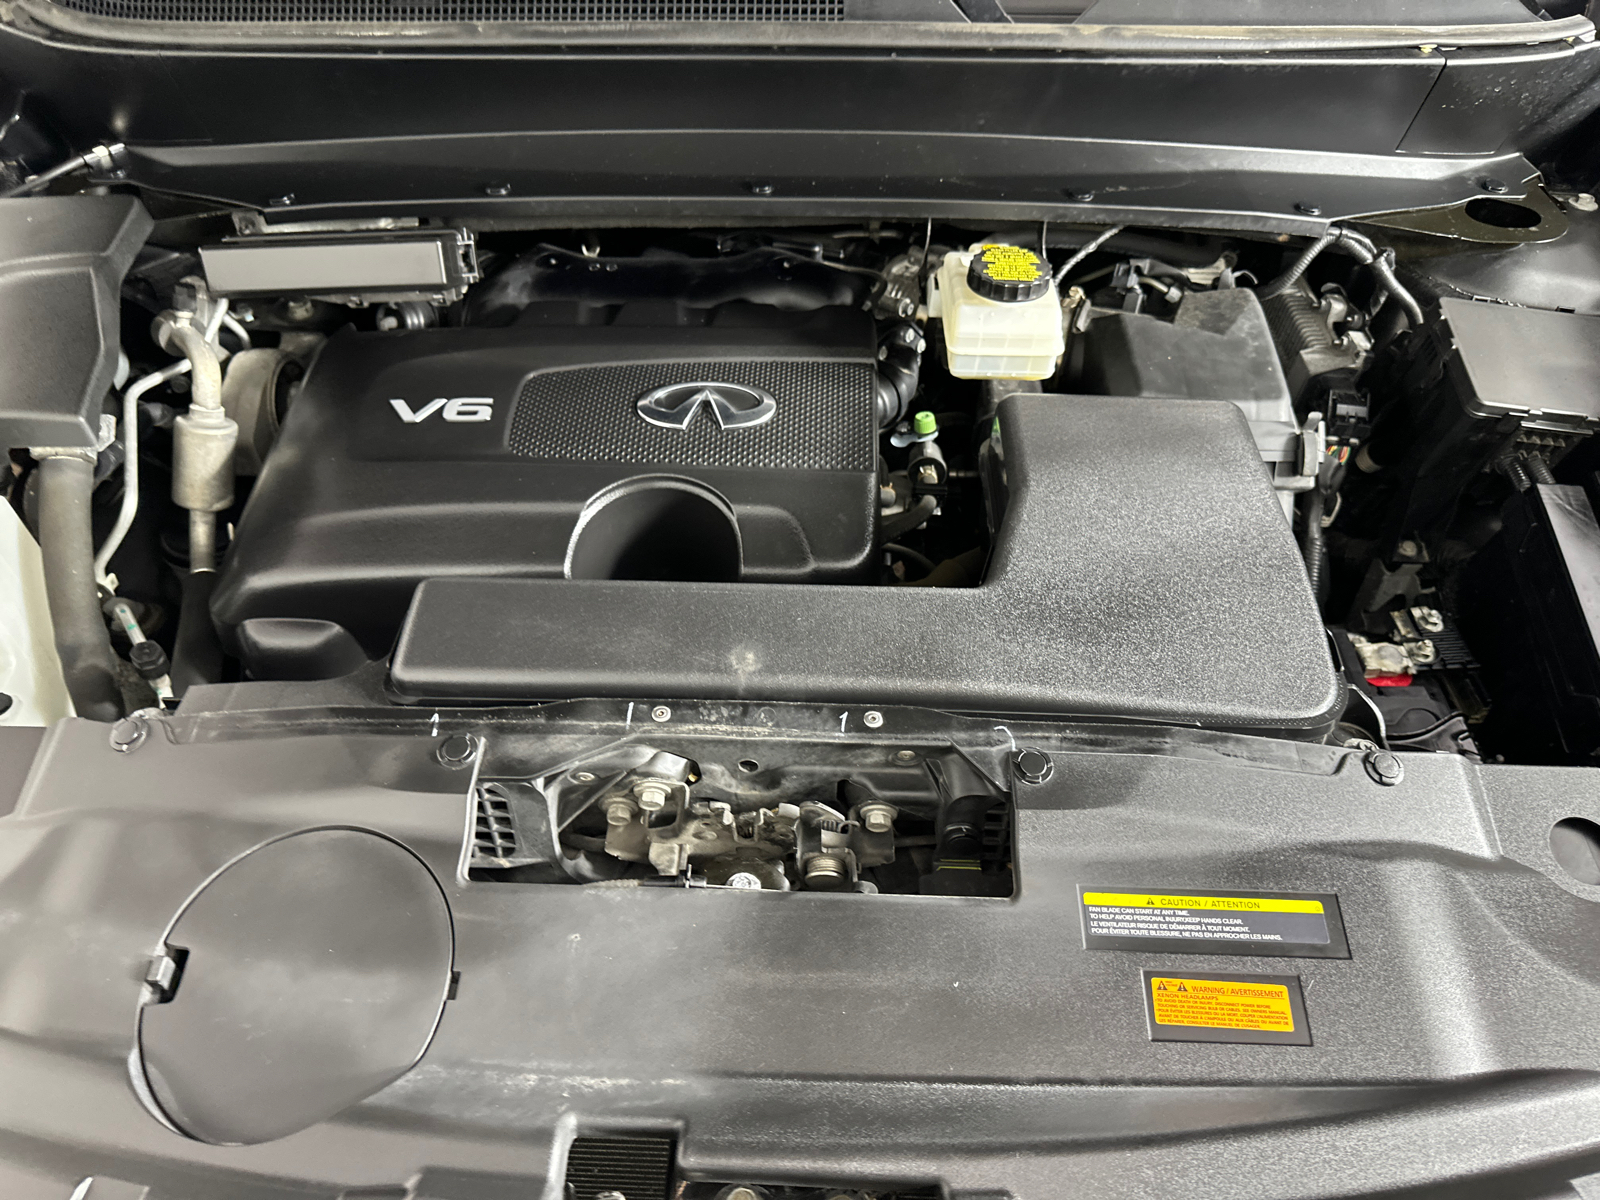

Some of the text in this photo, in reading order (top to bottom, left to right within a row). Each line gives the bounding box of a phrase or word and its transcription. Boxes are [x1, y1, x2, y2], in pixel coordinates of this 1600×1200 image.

[389, 398, 494, 422] V6
[1160, 898, 1200, 907] CAUTION
[1211, 900, 1260, 909] ATTENTION
[1191, 986, 1225, 994] WARNING
[1230, 988, 1283, 998] AVERTISSEMENT
